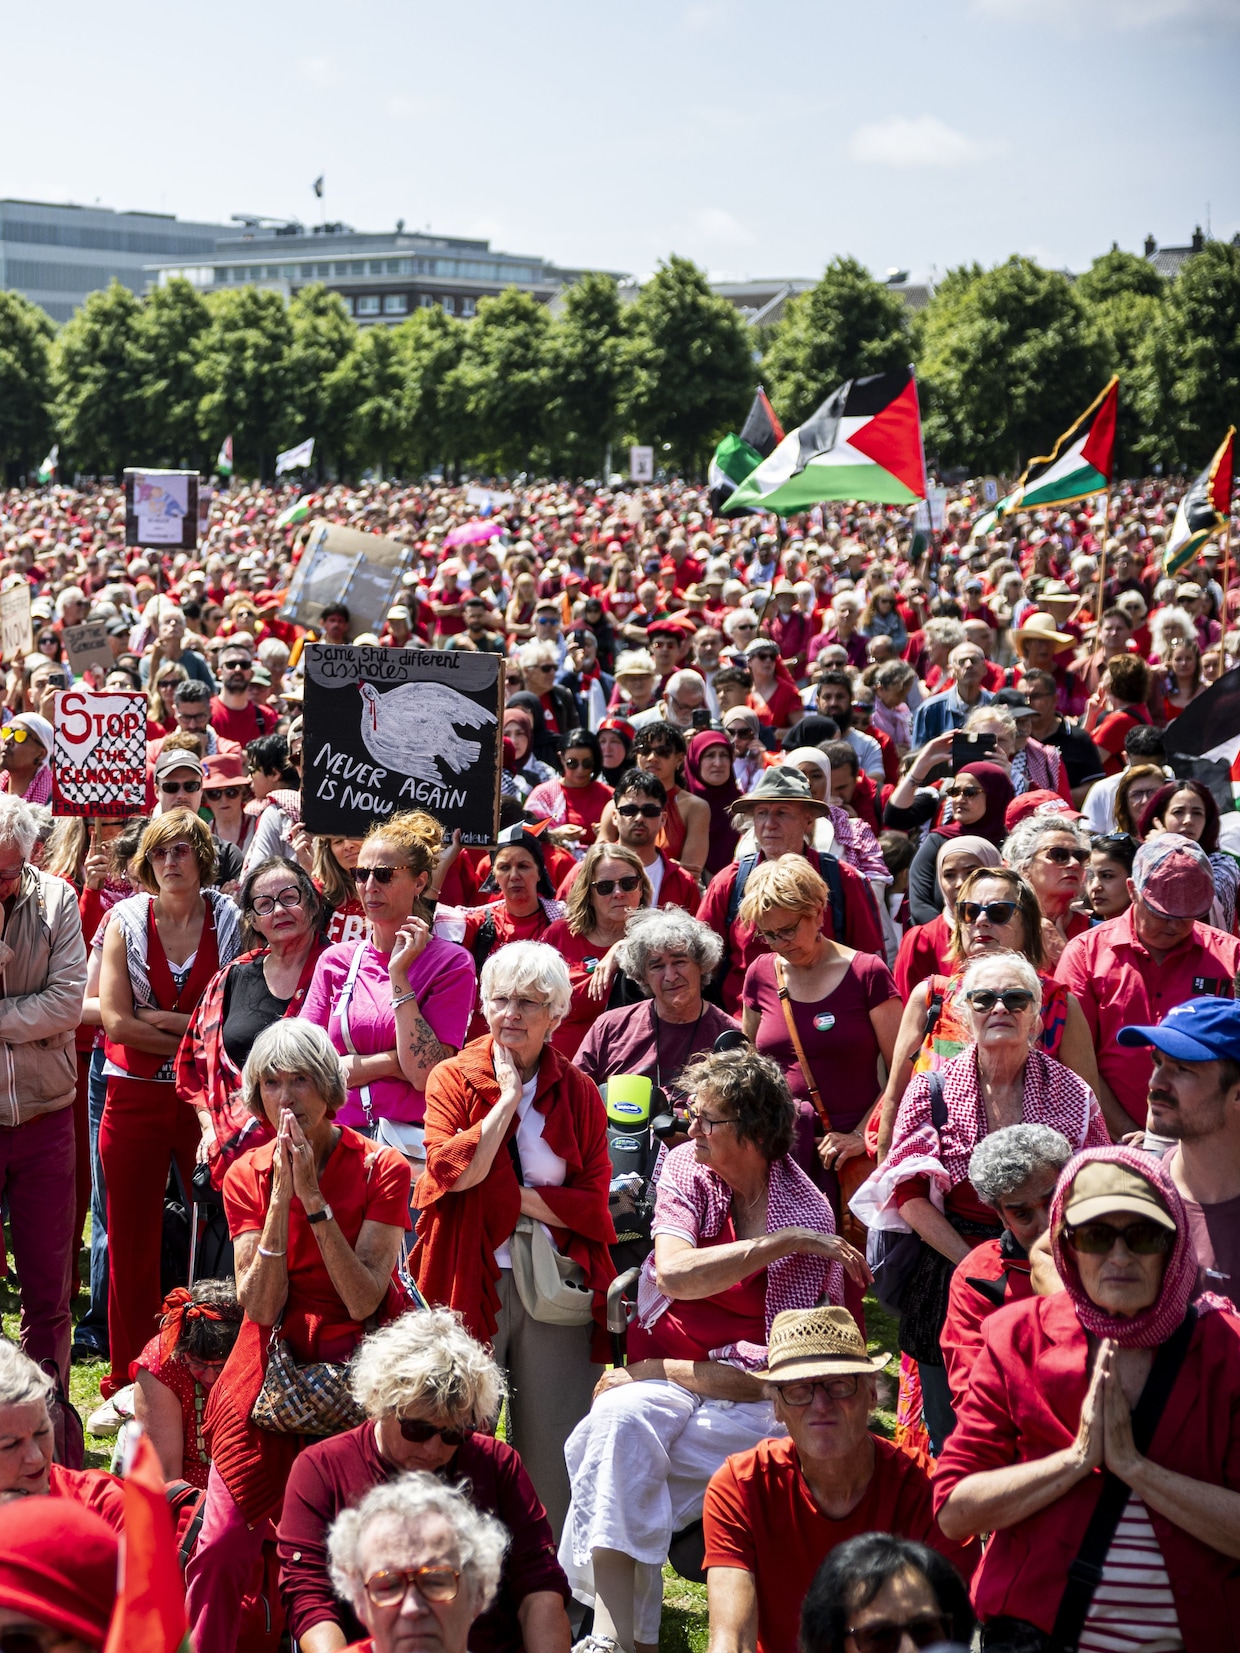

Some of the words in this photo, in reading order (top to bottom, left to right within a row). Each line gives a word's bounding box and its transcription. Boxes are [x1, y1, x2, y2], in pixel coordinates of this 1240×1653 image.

[312, 644, 355, 662] Same
[399, 649, 461, 669] different
[321, 657, 408, 680] assholes
[61, 692, 139, 745] STOP
[95, 749, 128, 762] THE
[313, 742, 388, 788] NEVER
[60, 766, 146, 785] GENOCIDE
[54, 800, 86, 814] FREE
[89, 801, 141, 815] PALESTINE
[340, 785, 394, 815] NOW
